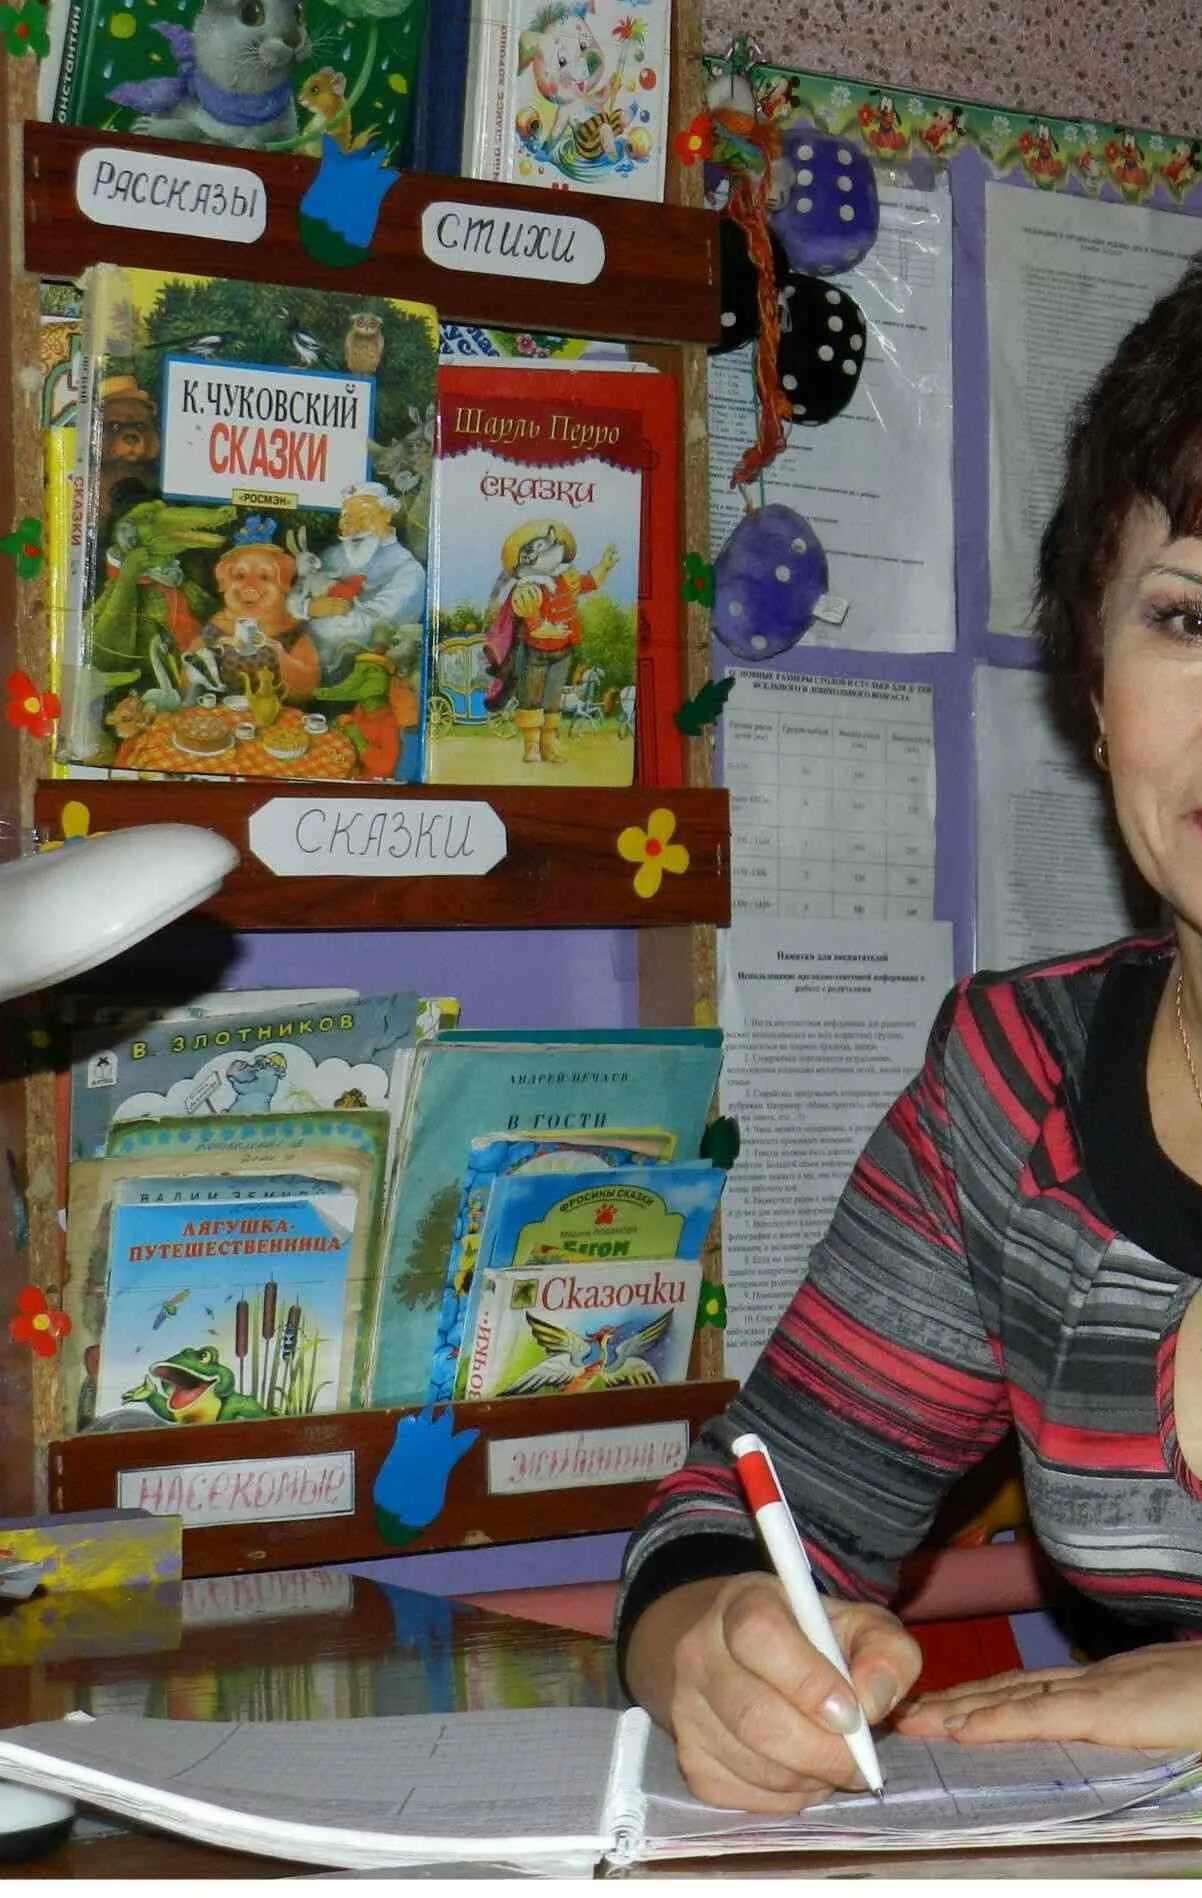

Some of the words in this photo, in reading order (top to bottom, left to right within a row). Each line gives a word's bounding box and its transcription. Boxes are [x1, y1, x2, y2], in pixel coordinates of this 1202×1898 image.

[92, 161, 258, 218] РАССКАЗЫ
[455, 407, 541, 443] Шарль
[549, 415, 621, 450] Перро
[208, 422, 328, 482] СКАЗКИ
[295, 807, 475, 860] СКАЗКИ
[171, 1014, 355, 1053] ЗЛОТНИКОВ
[506, 1112, 520, 1130] В
[532, 1111, 608, 1129] ГОСТИ
[128, 1236, 342, 1263] ПУТЕШЕСТВЕННИЦА
[541, 1271, 687, 1311] Сказочки
